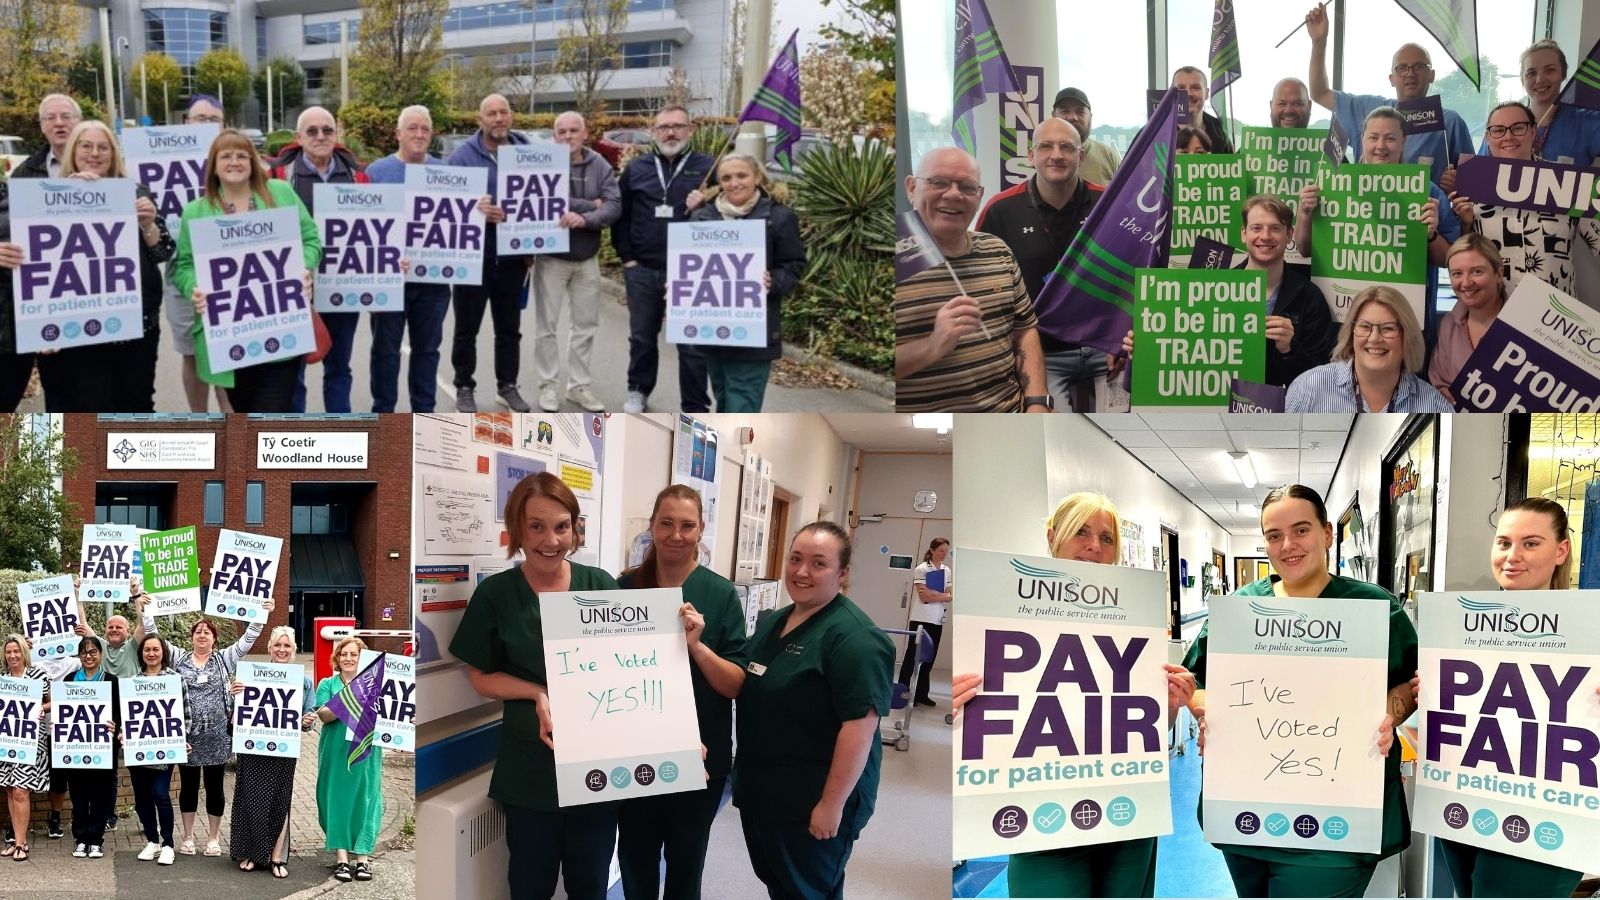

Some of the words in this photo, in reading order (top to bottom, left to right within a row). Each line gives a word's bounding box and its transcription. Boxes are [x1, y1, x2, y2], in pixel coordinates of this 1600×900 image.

[149, 136, 197, 148] UNISON
[1244, 131, 1273, 150] I'm
[138, 159, 208, 190] PAY
[1187, 159, 1242, 182] proud
[1245, 154, 1261, 172] to
[1267, 154, 1289, 173] be
[1294, 155, 1310, 174] in
[426, 175, 467, 186] UNISON
[507, 174, 562, 198] PAY
[1178, 183, 1201, 202] be
[1207, 182, 1224, 201] in
[1229, 188, 1241, 201] a
[1318, 169, 1351, 191] I'm
[1358, 171, 1425, 196] proud
[1495, 163, 1600, 212] UNI
[44, 191, 106, 206] UNISON
[337, 194, 382, 205] UNISON
[414, 196, 478, 224] PAY
[500, 197, 566, 222] FAIR
[1319, 196, 1340, 217] to
[1346, 196, 1373, 219] be
[1379, 197, 1400, 220] in
[1407, 203, 1422, 220] a
[220, 222, 273, 240] UNISON
[325, 218, 395, 247] PAY
[405, 222, 482, 251] FAIR
[692, 230, 739, 241] UNISON
[1119, 216, 1142, 235] the
[1331, 222, 1407, 248] TRADE
[28, 222, 126, 262] PAY
[209, 246, 292, 291] PAY
[318, 246, 401, 274] FAIR
[679, 253, 755, 280] PAY
[1332, 248, 1402, 275] UNION
[20, 257, 136, 300] FAIR
[206, 279, 306, 326] FAIR
[671, 280, 762, 308] FAIR
[1140, 275, 1181, 301] I'm
[1188, 277, 1261, 307] proud
[20, 303, 43, 315] for
[47, 298, 102, 316] patient
[106, 294, 139, 306] care
[232, 317, 278, 337] patient
[281, 312, 309, 324] care
[1141, 307, 1167, 333] to
[1174, 307, 1205, 333] be
[1213, 307, 1235, 333] in
[1243, 313, 1258, 334] a
[1155, 338, 1243, 365] TRADE
[1544, 333, 1567, 352] public
[1460, 368, 1497, 409] to
[139, 440, 157, 448] GIG
[262, 437, 276, 450] Tŷ
[281, 436, 317, 448] Coetir
[139, 451, 157, 459] NHS
[262, 453, 322, 463] Woodland
[327, 453, 364, 463] House
[142, 537, 160, 549] I'm
[162, 529, 194, 549] proud
[234, 538, 266, 550] UNISON
[87, 545, 129, 562] PAY
[144, 551, 156, 563] to
[157, 548, 171, 560] be
[174, 546, 185, 558] in
[187, 546, 194, 556] a
[221, 552, 272, 578] PAY
[82, 562, 131, 580] FAIR
[151, 559, 189, 575] TRADE
[32, 583, 60, 594] UNISON
[153, 573, 188, 589] UNION
[212, 571, 272, 599] FAIR
[1017, 578, 1118, 606] UNISON
[27, 596, 70, 621] PAY
[157, 597, 188, 609] UNISON
[1018, 605, 1033, 614] the
[1035, 606, 1064, 616] public
[1066, 610, 1099, 619] service
[1100, 611, 1127, 620] union
[26, 613, 78, 638] FAIR
[580, 606, 648, 624] UNISON
[1464, 613, 1559, 634] UNISON
[593, 627, 613, 636] public
[1255, 618, 1342, 639] UNISON
[1255, 642, 1267, 651] the
[1268, 642, 1293, 652] public
[1294, 644, 1322, 652] service
[1324, 644, 1348, 653] union
[1464, 637, 1477, 645] the
[1478, 637, 1504, 647] public
[1506, 639, 1537, 648] service
[1538, 639, 1567, 649] union
[384, 660, 411, 672] NISON
[555, 647, 598, 675] I've
[982, 629, 1150, 693] PAY
[253, 669, 287, 679] UNISON
[66, 688, 96, 696] UNISON
[135, 683, 166, 692] UNISON
[243, 686, 297, 710] PAY
[381, 678, 415, 702] AY
[1228, 677, 1296, 707] I've
[1439, 658, 1592, 724] PAY
[58, 704, 106, 724] PAY
[128, 698, 177, 721] PAY
[237, 705, 300, 730] FAIR
[377, 699, 415, 724] AIR
[54, 723, 110, 743] FAIR
[124, 717, 184, 740] FAIR
[961, 694, 1161, 760] FAIR
[1425, 710, 1600, 789] FAIR
[956, 764, 1000, 787] for
[1008, 759, 1104, 788] patient
[1110, 758, 1164, 777] care
[1422, 763, 1451, 782] for
[1456, 771, 1536, 800] patient
[1542, 787, 1600, 811] care
